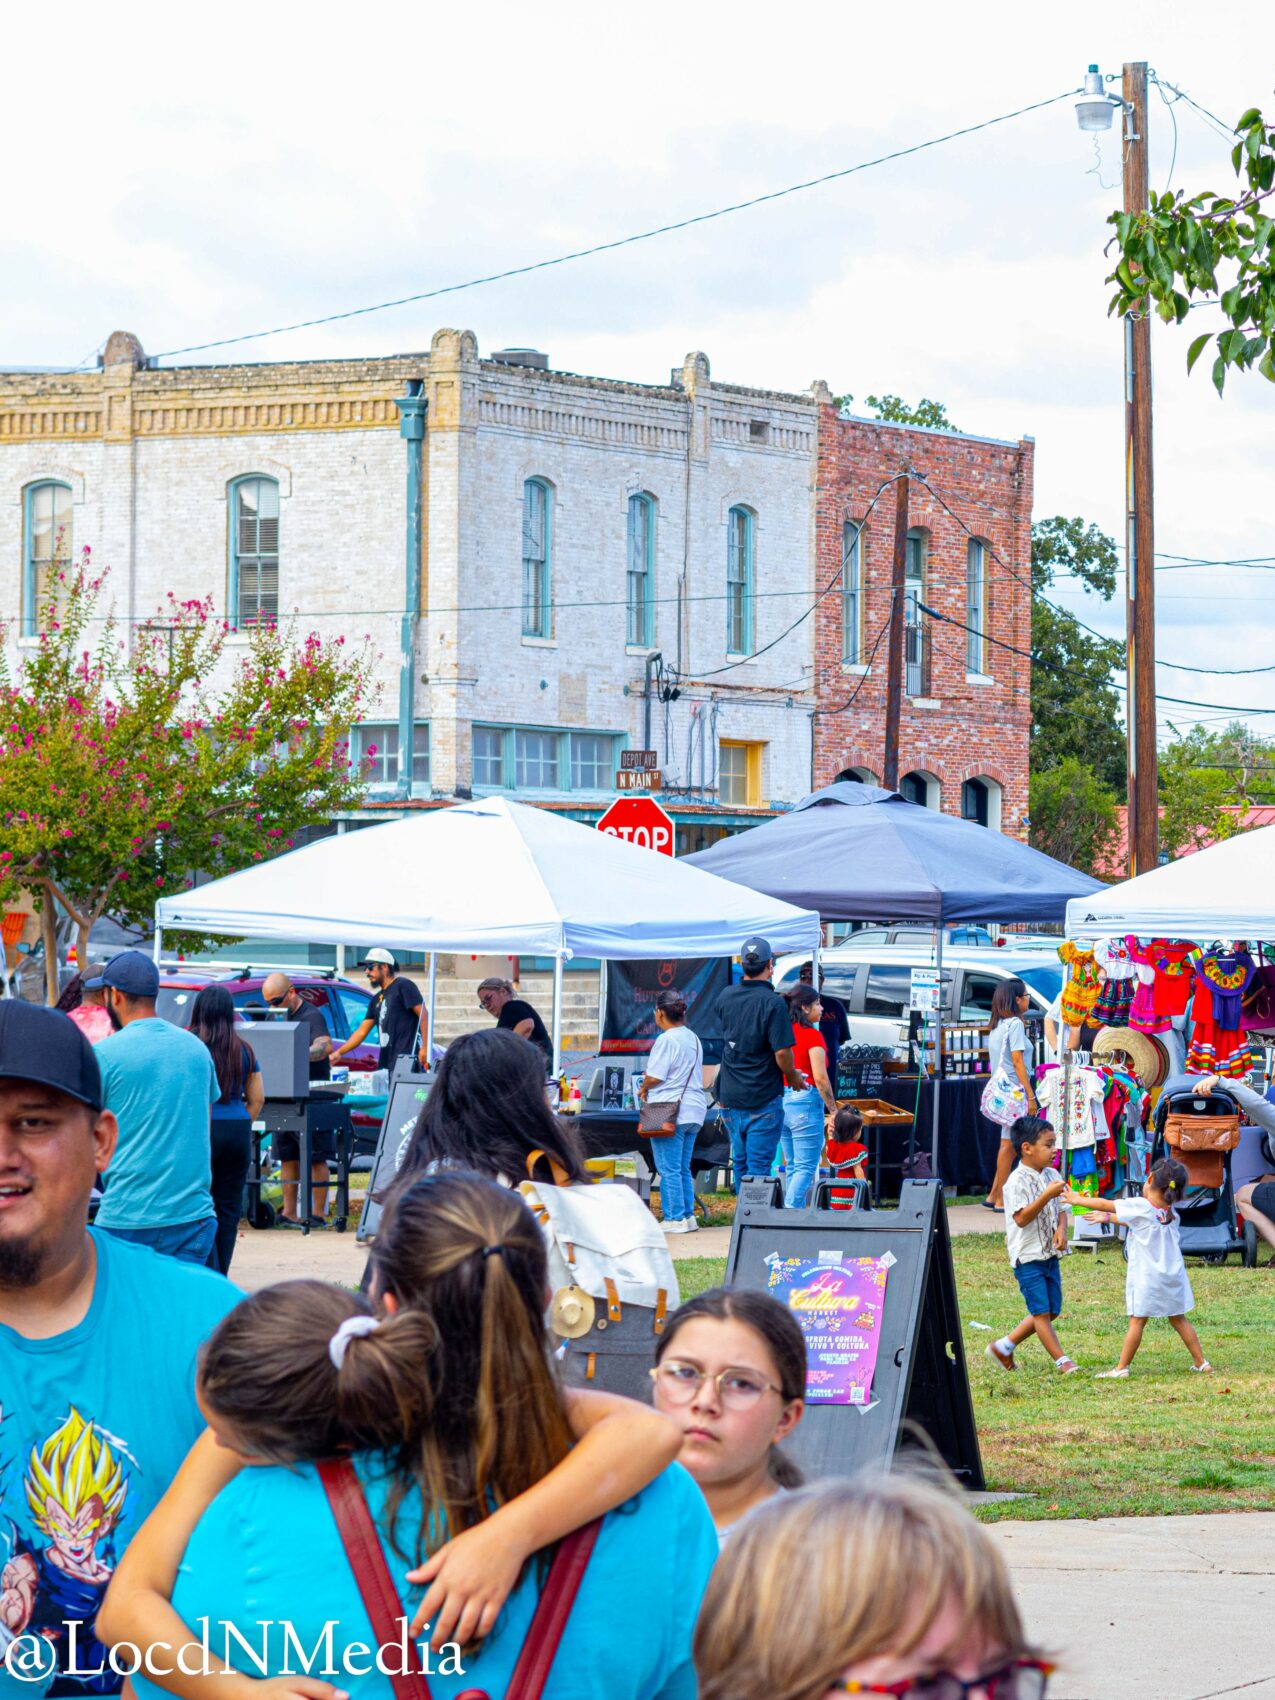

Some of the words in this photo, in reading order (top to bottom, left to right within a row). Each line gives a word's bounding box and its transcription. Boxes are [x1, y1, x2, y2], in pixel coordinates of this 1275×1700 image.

[622, 753, 643, 767] DEPOT
[644, 753, 656, 767] AVE
[620, 774, 626, 788] N
[629, 773, 652, 788] MAIN
[653, 772, 660, 780] ST
[604, 826, 669, 851] TOP
[810, 1272, 844, 1292] La
[789, 1289, 860, 1311] Cultura
